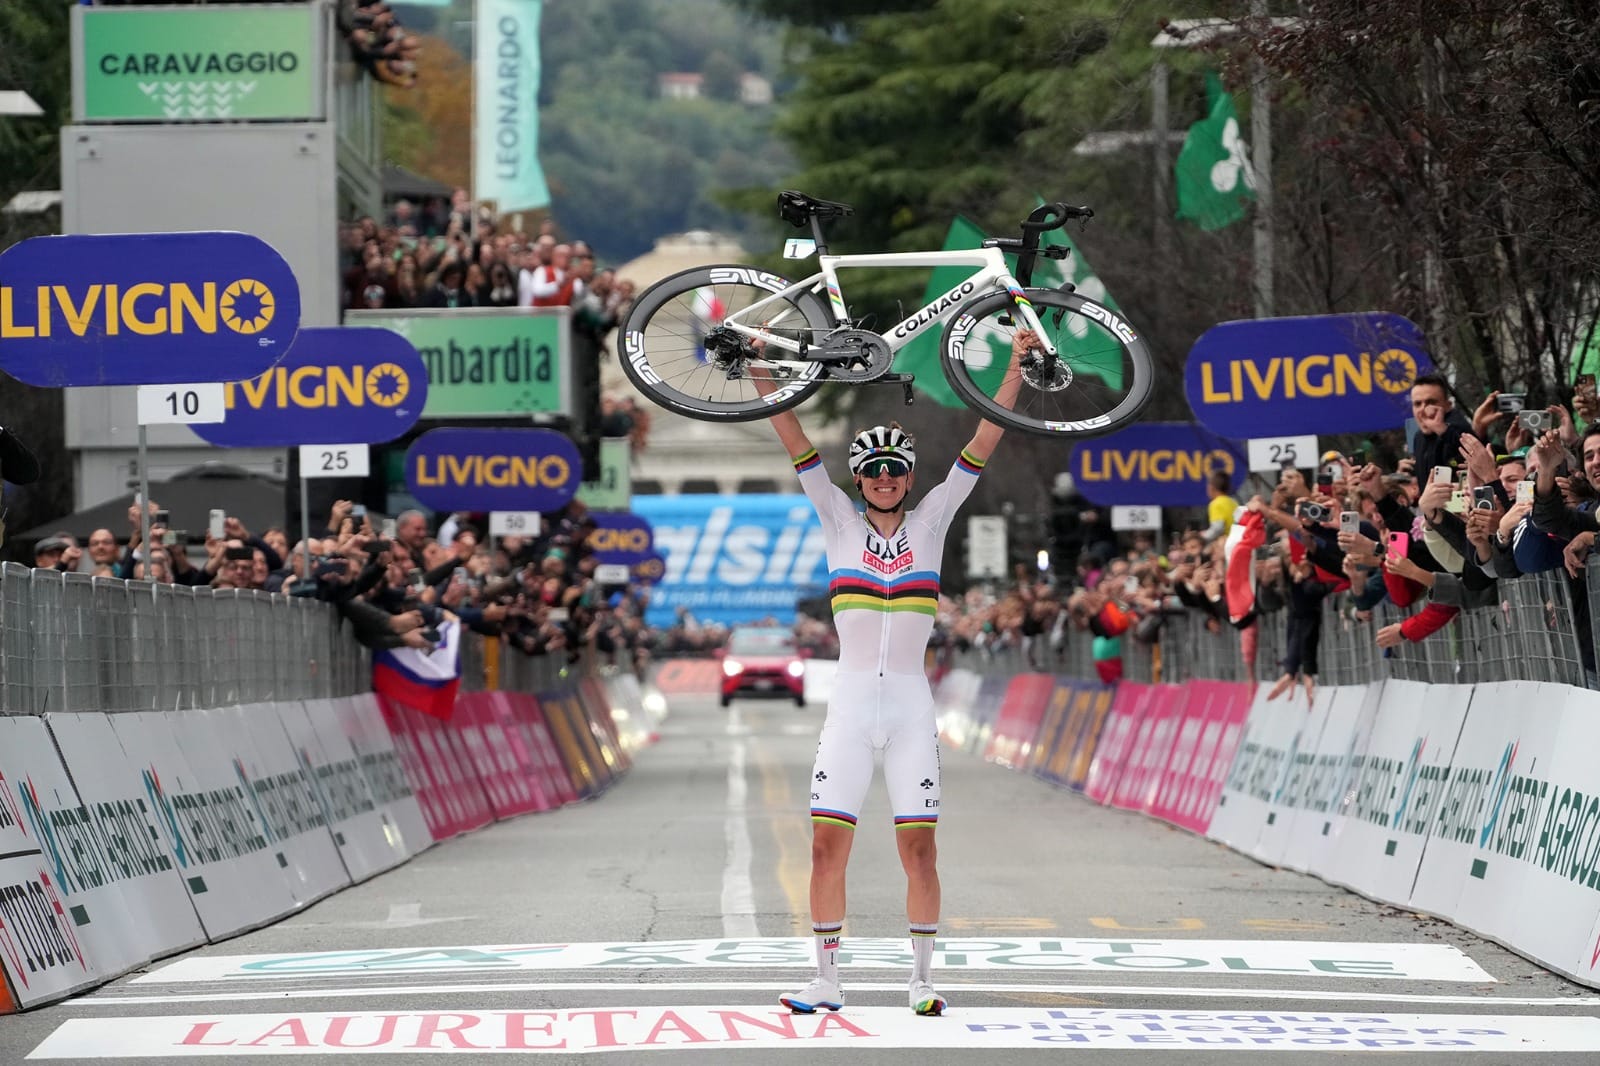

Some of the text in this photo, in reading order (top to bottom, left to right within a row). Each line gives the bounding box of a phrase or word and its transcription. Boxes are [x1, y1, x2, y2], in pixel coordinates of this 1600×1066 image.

[100, 52, 298, 75] CARAVAGGIO
[498, 16, 520, 180] LEONARDO
[789, 243, 799, 258] 1
[0, 278, 275, 338] LIVIGNO
[894, 281, 975, 339] COLNAGO
[421, 337, 552, 385] mbardia
[224, 362, 410, 409] IVIGNO
[1201, 349, 1418, 404] LIVIGNO
[166, 391, 199, 416] 10
[321, 451, 349, 470] 25
[1081, 449, 1235, 482] LIVIGNO
[1270, 443, 1297, 464] 25
[417, 455, 570, 488] LIVIGNO
[505, 514, 526, 529] 50
[1128, 510, 1149, 524] 50
[866, 533, 910, 561] UAE
[90, 798, 173, 882] AGRICOLE
[584, 952, 1408, 977] AGRICOLE
[172, 1009, 881, 1049] LAURETANA
[1143, 1022, 1507, 1036] leggera
